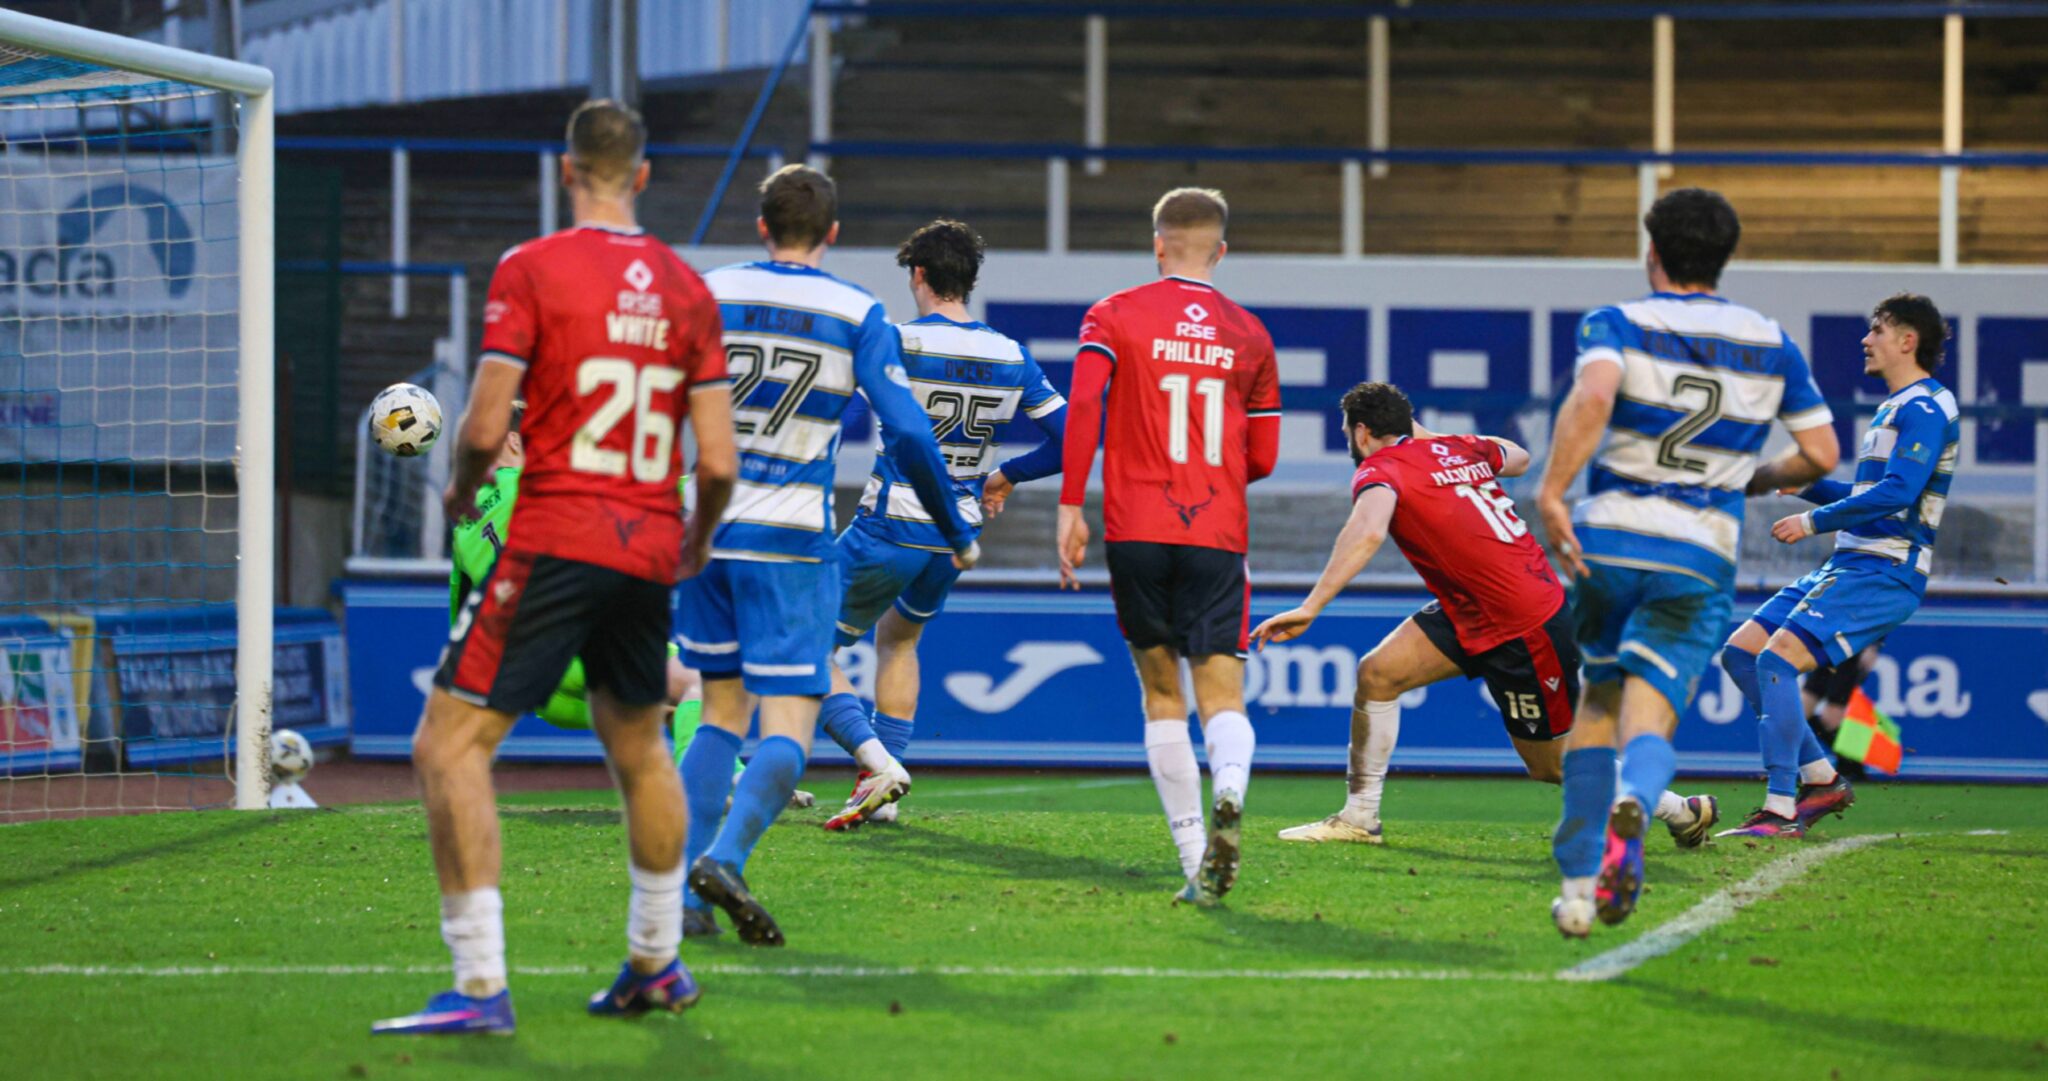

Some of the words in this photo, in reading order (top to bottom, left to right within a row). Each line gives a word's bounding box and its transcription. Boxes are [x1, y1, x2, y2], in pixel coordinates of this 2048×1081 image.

[606, 310, 671, 350] WHITE
[744, 305, 815, 334] WILSON
[1175, 322, 1217, 340] RSE
[944, 360, 994, 382] OWENS
[1152, 339, 1235, 370] PHILLIPS
[726, 343, 822, 437] 27
[570, 357, 686, 483] 26
[926, 390, 1004, 467] 25
[1159, 373, 1226, 467] 11
[1656, 374, 1723, 474] 2
[1454, 481, 1528, 543] 16
[1504, 690, 1541, 719] 16
